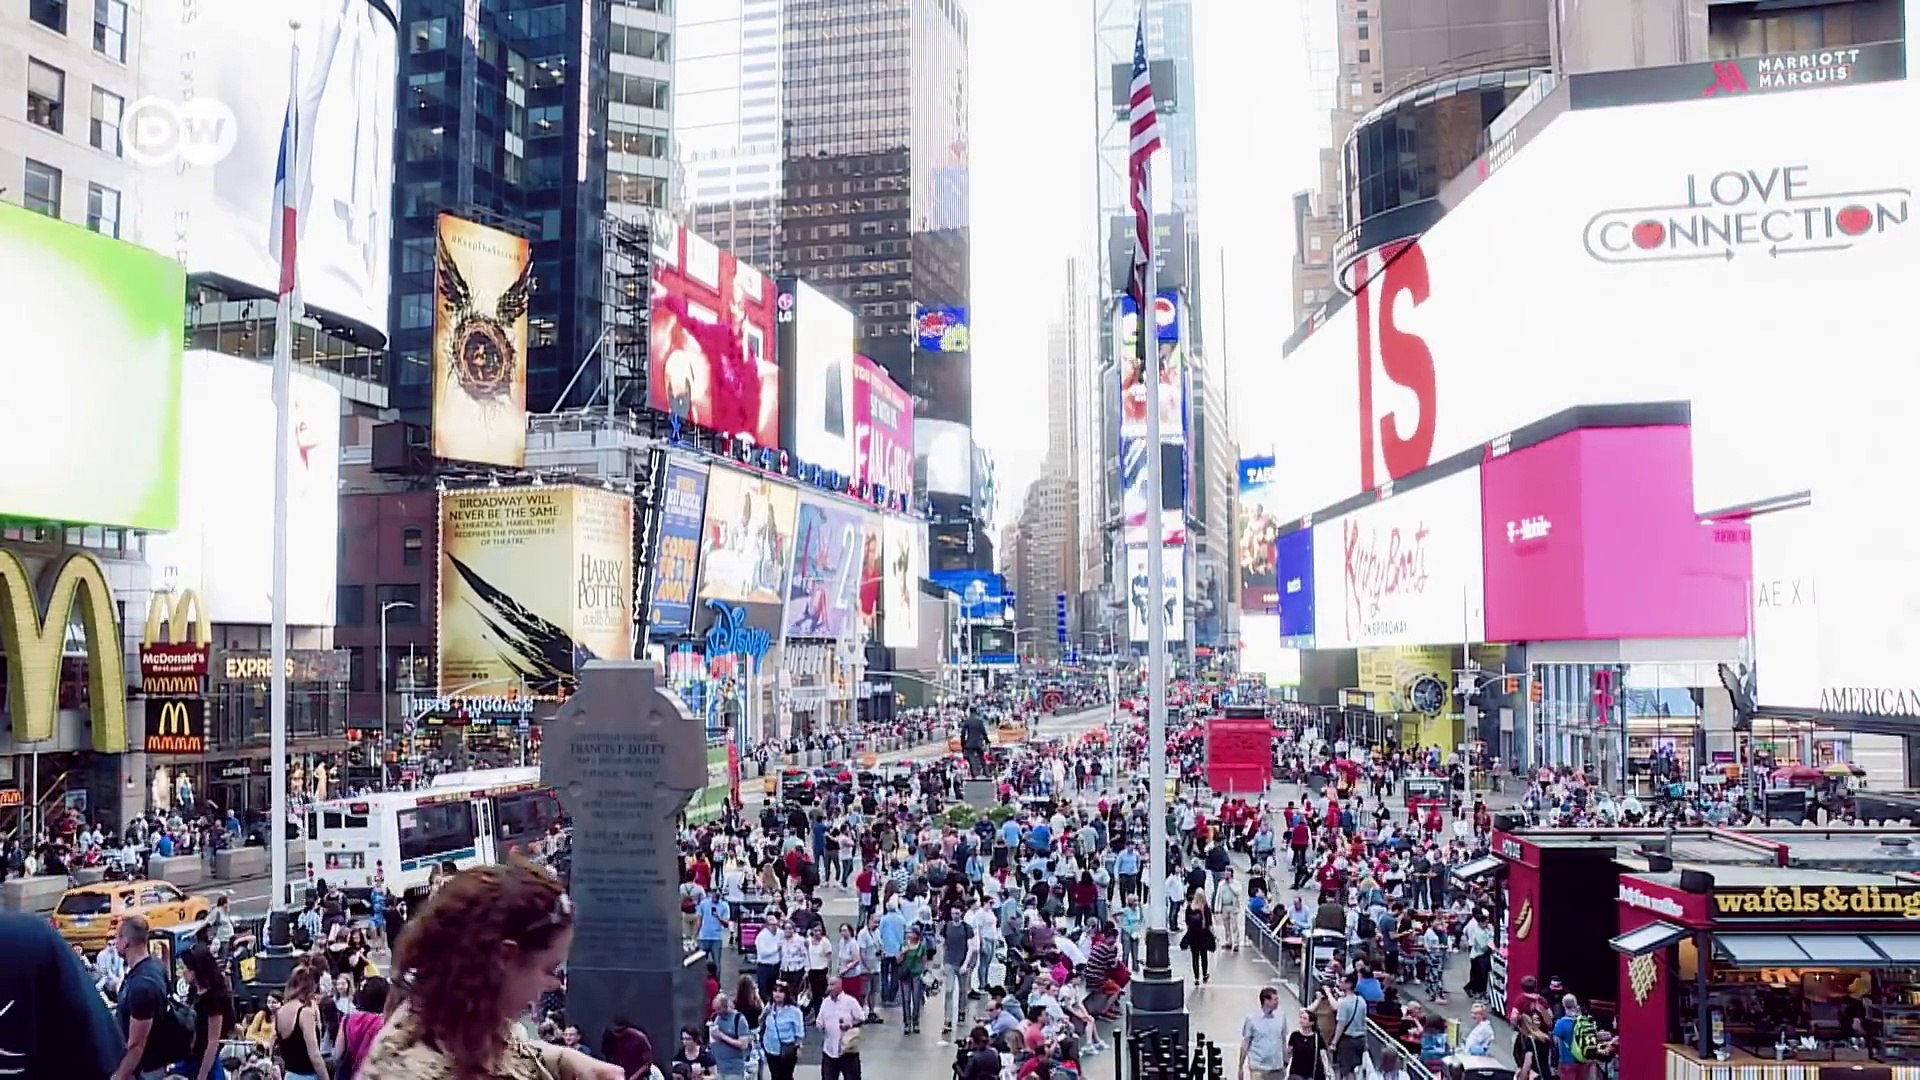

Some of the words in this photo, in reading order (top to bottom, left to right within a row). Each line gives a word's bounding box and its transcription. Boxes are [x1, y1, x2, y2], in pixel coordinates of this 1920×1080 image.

[1758, 49, 1860, 72] MARRIOTT
[1759, 66, 1848, 88] MARQUIS
[1688, 165, 1809, 207] LOVE
[1599, 200, 1909, 252] CONNECTION
[778, 310, 792, 323] LG
[526, 495, 553, 505] WILL
[449, 511, 484, 521] NEVER
[488, 509, 500, 520] BE
[505, 507, 526, 518] THE
[462, 520, 504, 529] THEATRICAL
[506, 518, 534, 528] MARVEL
[537, 517, 556, 525] THAT
[455, 530, 491, 538] REDEFINES
[493, 529, 505, 538] THE
[581, 553, 624, 586] HARRY
[577, 579, 627, 610] POTTER
[142, 652, 205, 665] McDonald's
[152, 664, 194, 672] Restaurant
[225, 657, 294, 678] EXPRES
[462, 697, 534, 713] LUGGAGE
[1820, 687, 1920, 717] AMERICAN
[570, 743, 616, 754] FRANCIS
[628, 743, 665, 754] DUFFY
